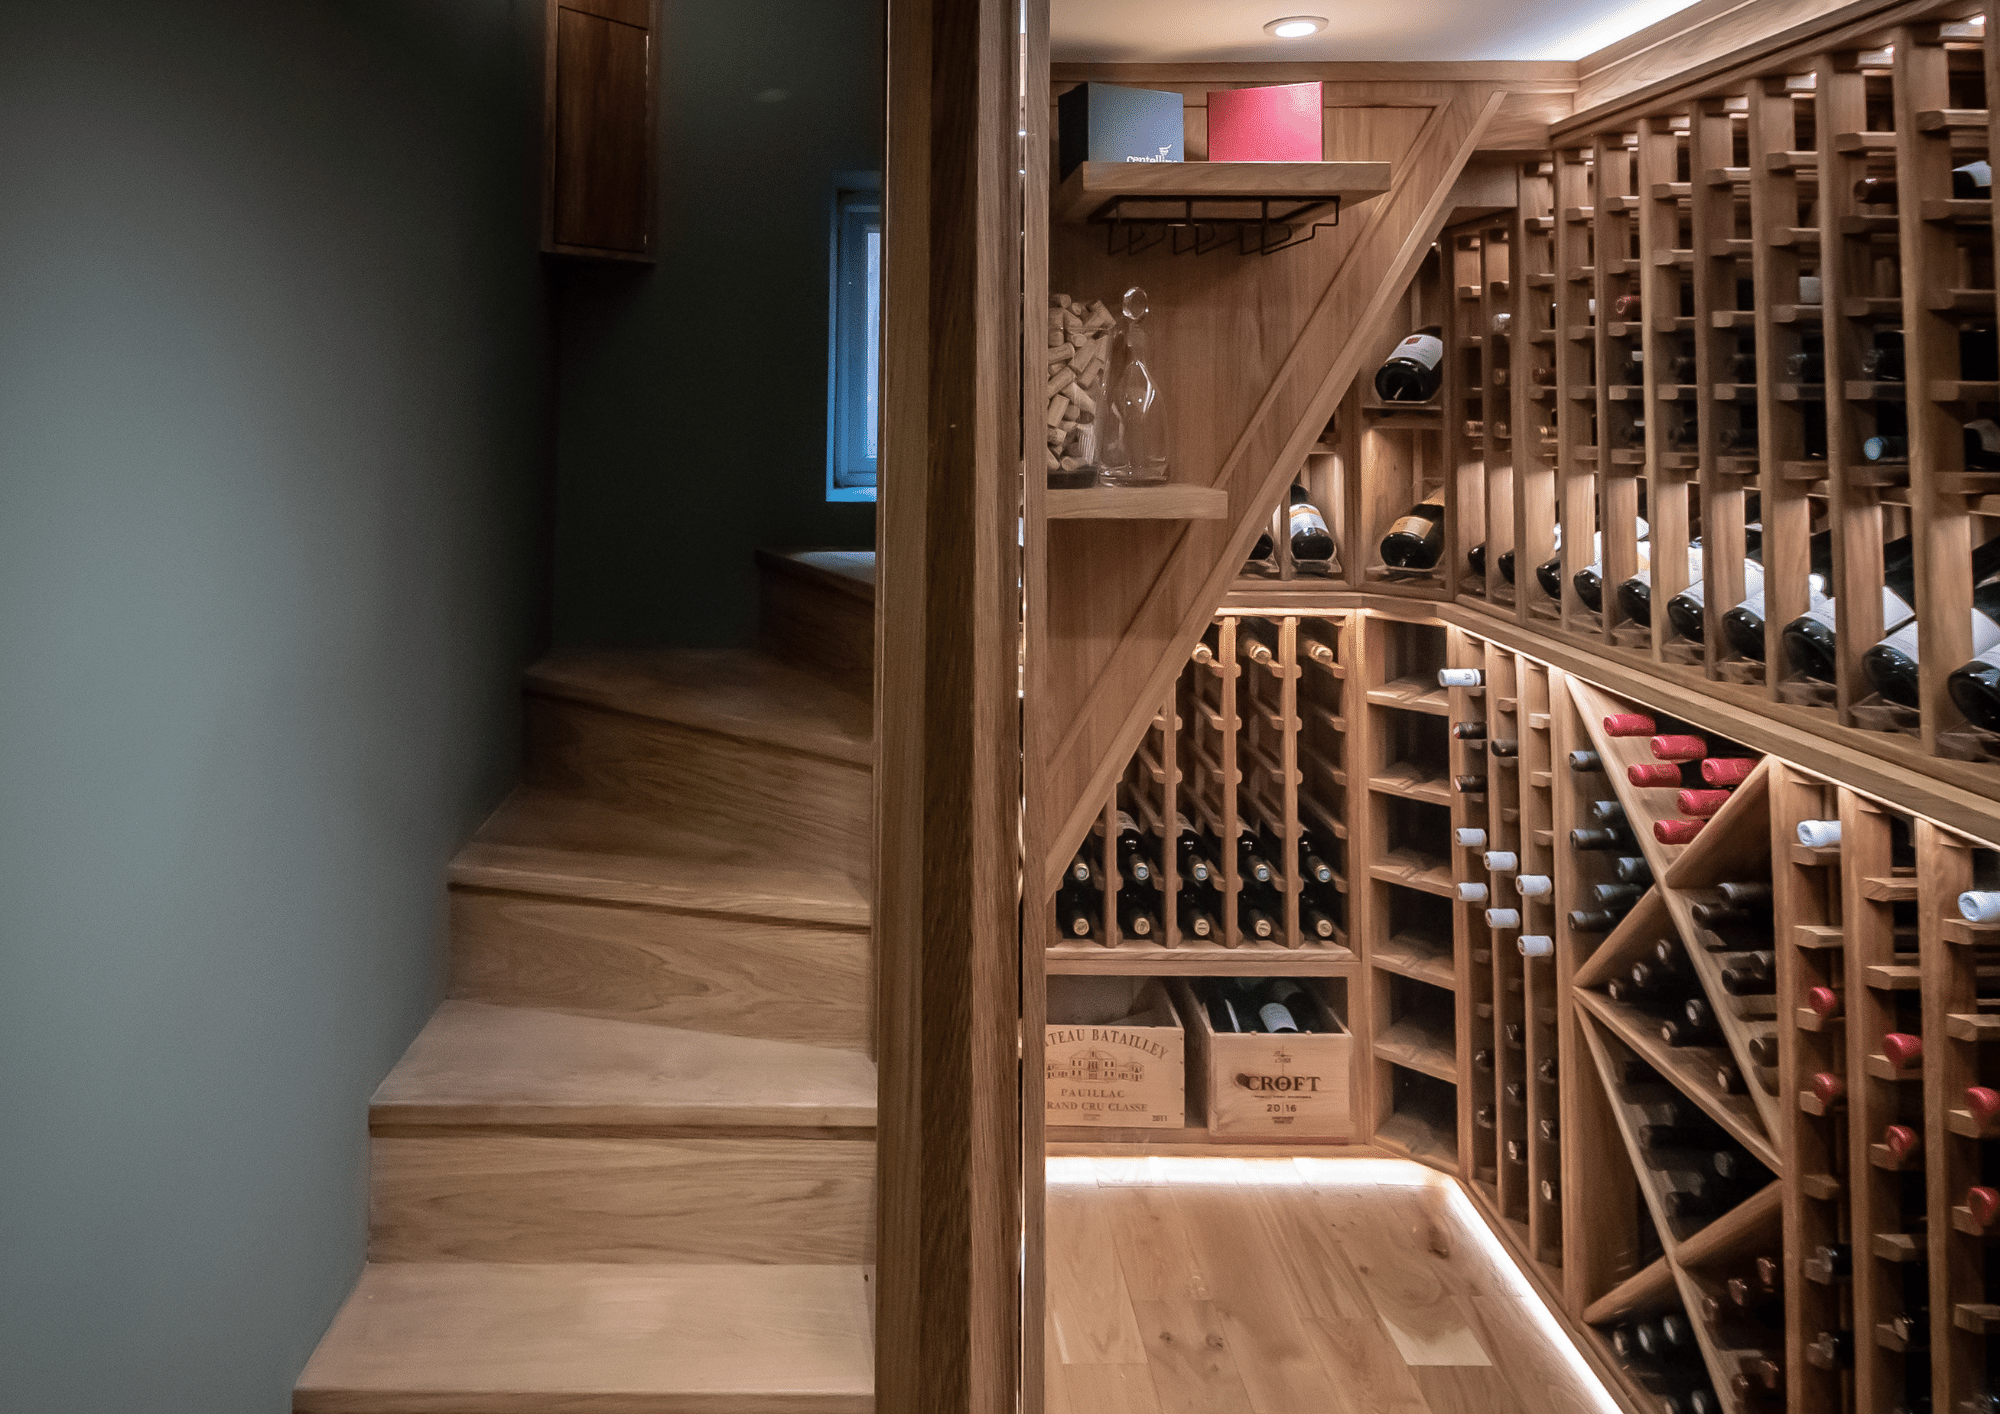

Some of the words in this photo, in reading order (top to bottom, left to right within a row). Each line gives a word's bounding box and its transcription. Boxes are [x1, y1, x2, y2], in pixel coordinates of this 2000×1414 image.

[1045, 1028, 1086, 1048] TEAU
[1091, 1028, 1170, 1060] BATAILLEY
[1246, 1075, 1322, 1092] CROFT
[1060, 1088, 1126, 1099] PAUILLAC
[1046, 1101, 1078, 1111] RAND
[1081, 1102, 1105, 1112] CRU
[1107, 1103, 1148, 1113] CLASSE
